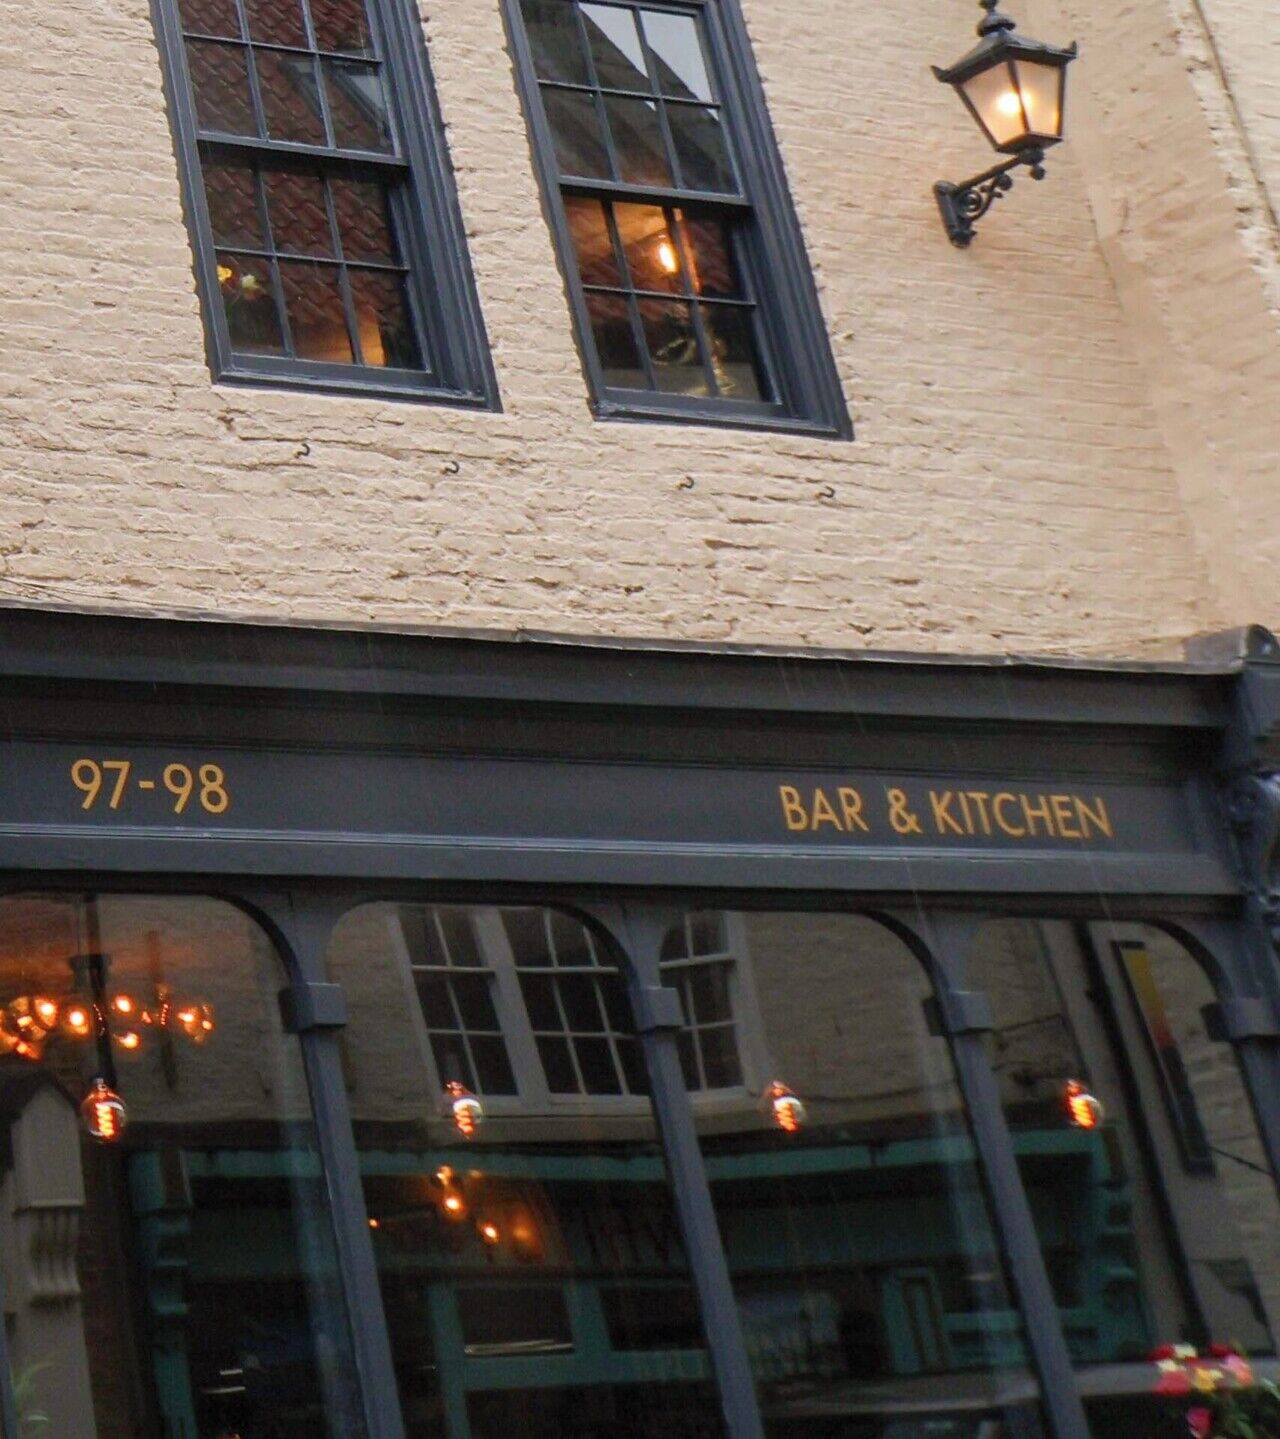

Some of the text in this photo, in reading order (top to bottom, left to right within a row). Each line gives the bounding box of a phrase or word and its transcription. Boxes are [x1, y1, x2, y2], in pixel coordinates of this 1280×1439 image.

[71, 759, 229, 814] 97-98
[778, 785, 1114, 838] BAR & KITCHEN
